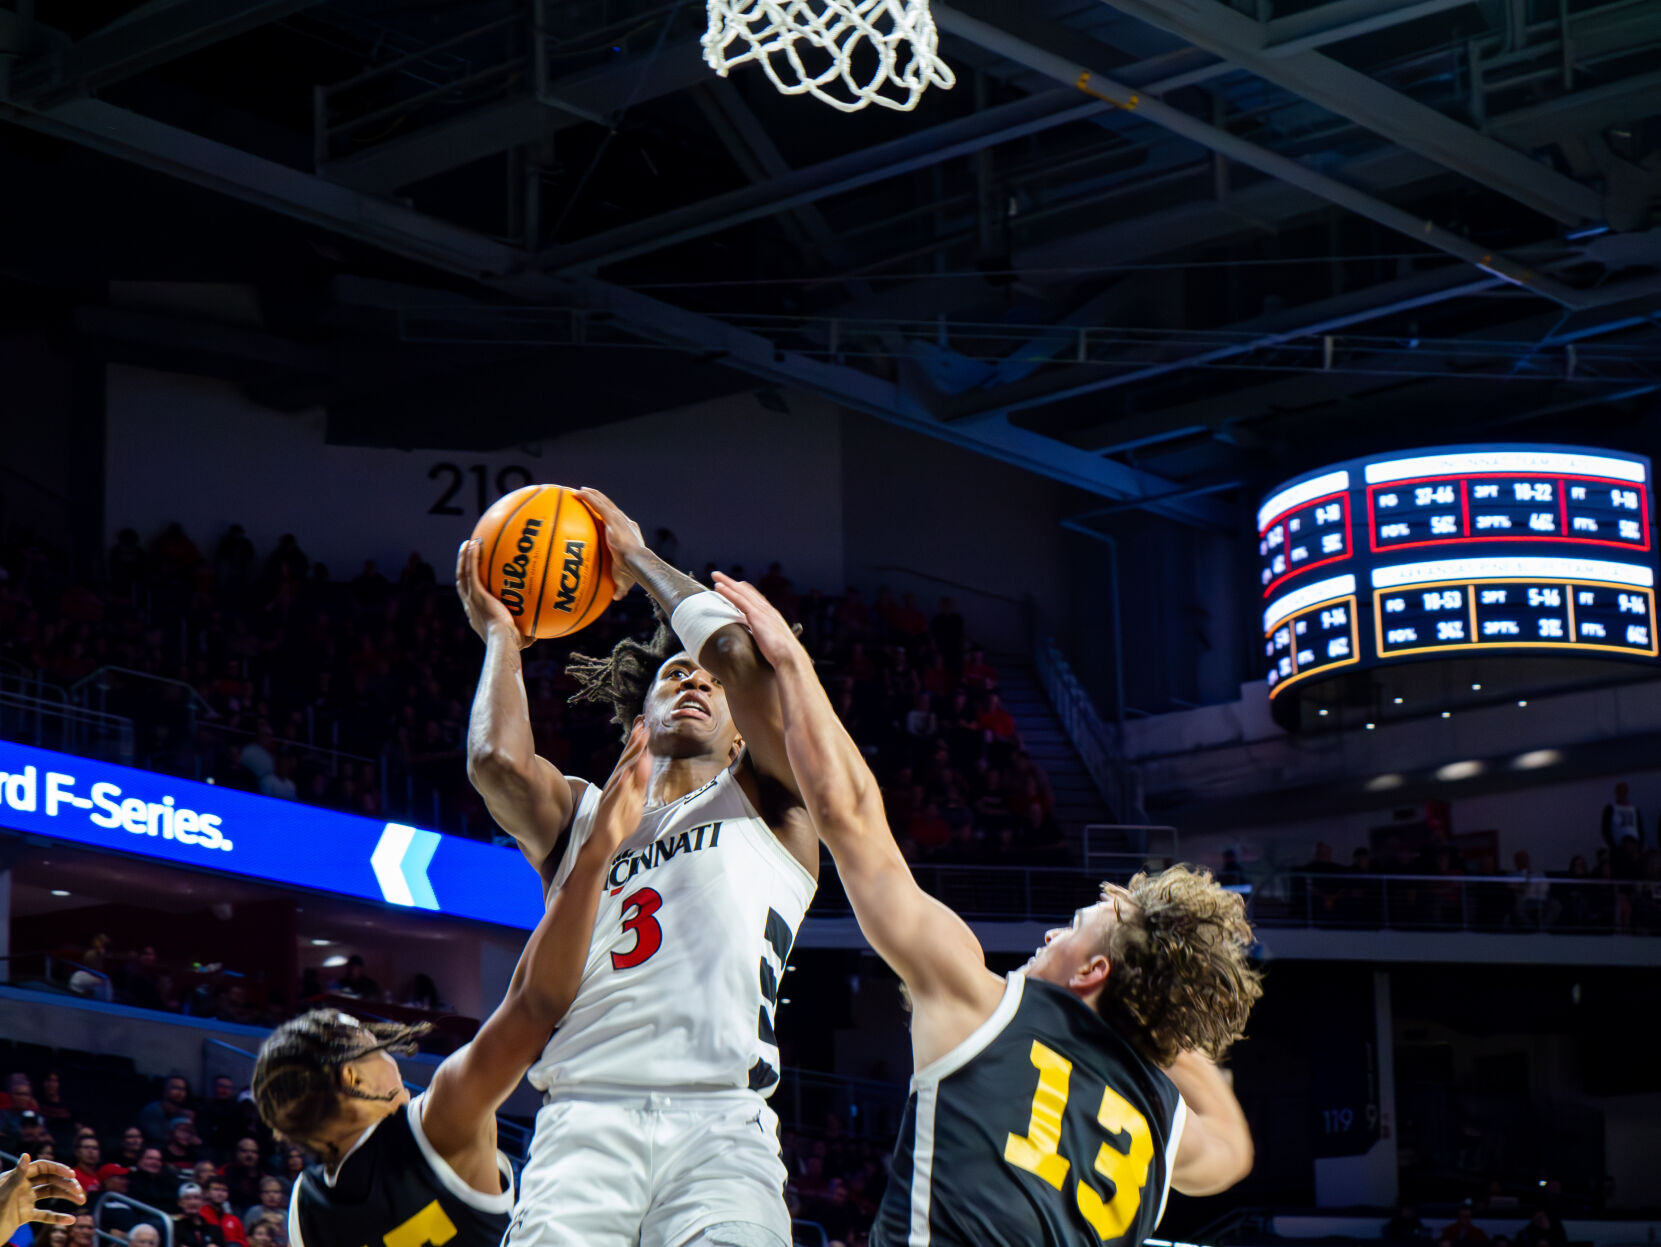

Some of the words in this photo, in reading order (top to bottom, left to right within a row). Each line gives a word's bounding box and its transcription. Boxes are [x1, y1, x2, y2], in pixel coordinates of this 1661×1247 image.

[500, 518, 544, 617] Wilson
[553, 539, 588, 614] NCAA
[46, 772, 234, 852] F-Series.
[610, 886, 664, 972] 3
[1004, 1039, 1155, 1242] 13
[1320, 1107, 1353, 1135] 119
